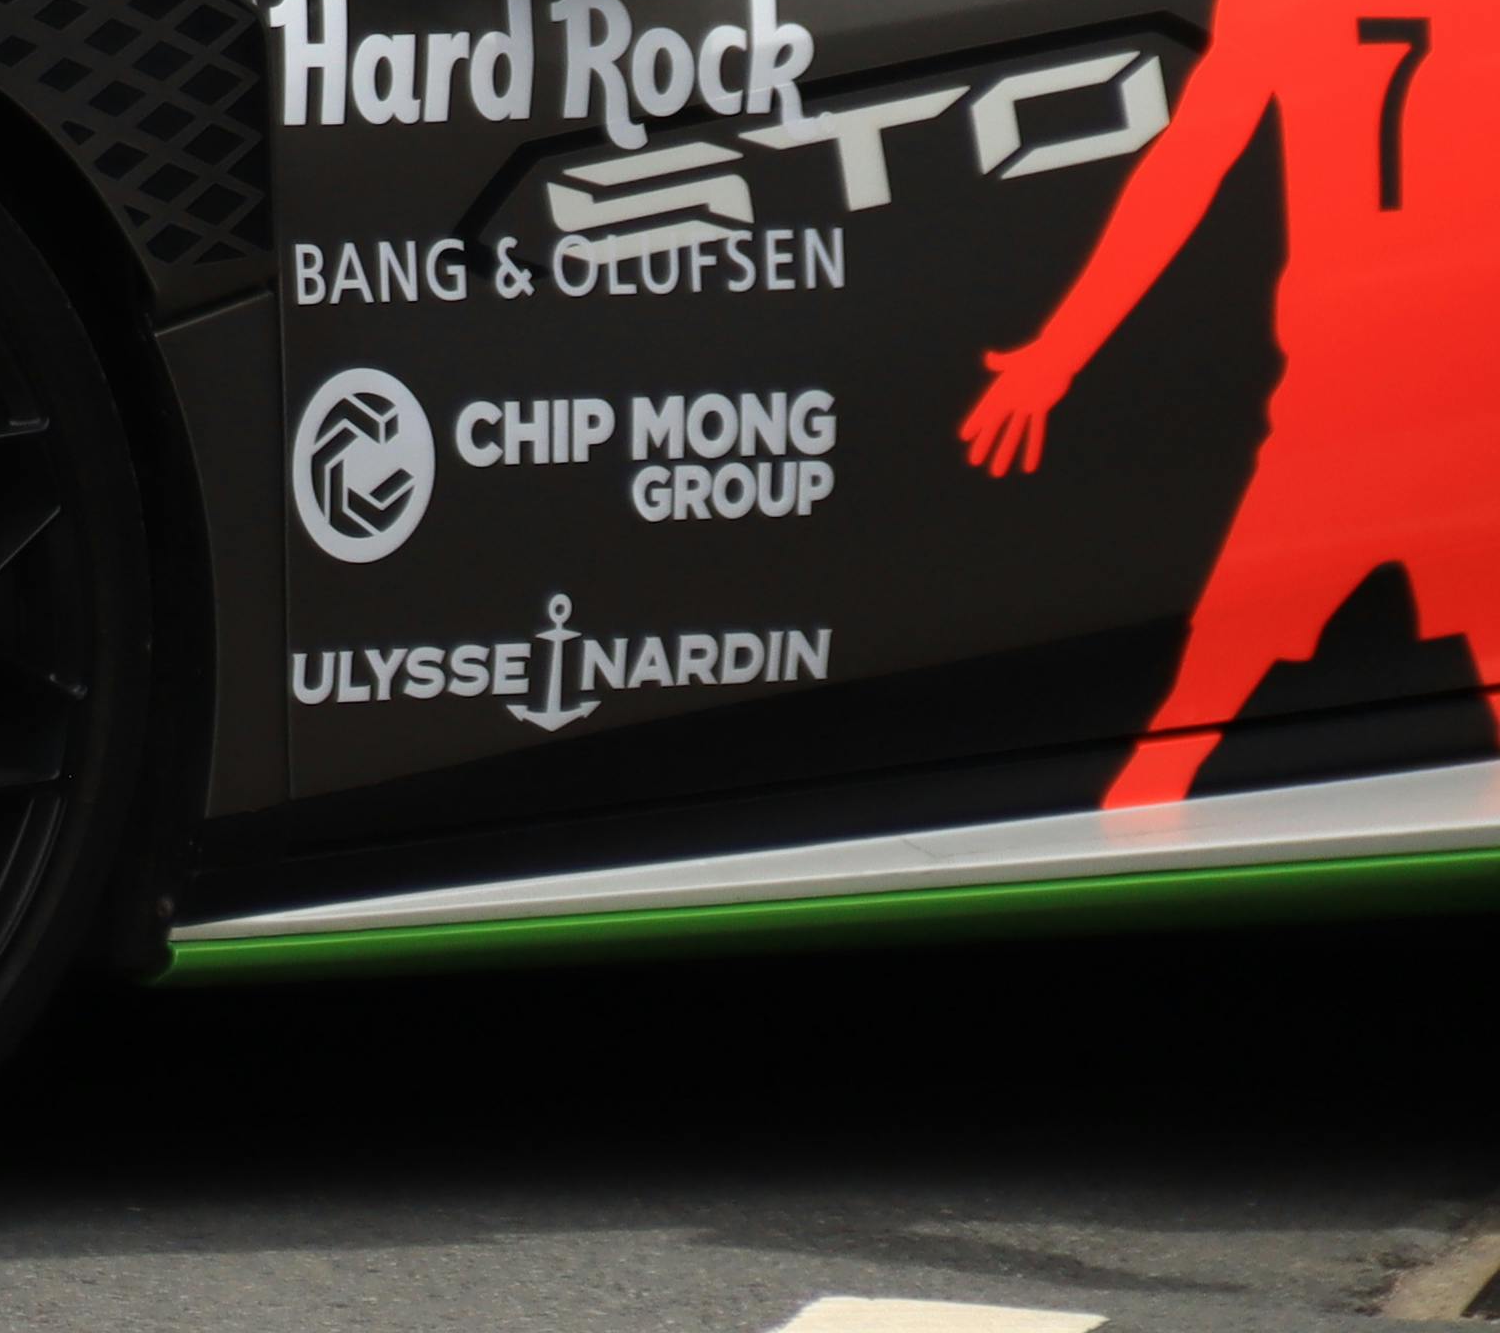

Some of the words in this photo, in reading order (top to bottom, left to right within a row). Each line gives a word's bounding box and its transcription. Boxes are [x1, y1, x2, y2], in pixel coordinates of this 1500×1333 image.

[1356, 17, 1432, 212] 7
[546, 49, 1171, 265] STO
[295, 237, 468, 306] BANG
[495, 235, 536, 301] &
[551, 227, 846, 298] OLUFSEN
[455, 397, 615, 468] CHIP
[631, 389, 837, 462] MONG
[630, 459, 835, 523] GROUP
[291, 642, 532, 705] ULYSSE
[579, 628, 833, 691] NARDIN
